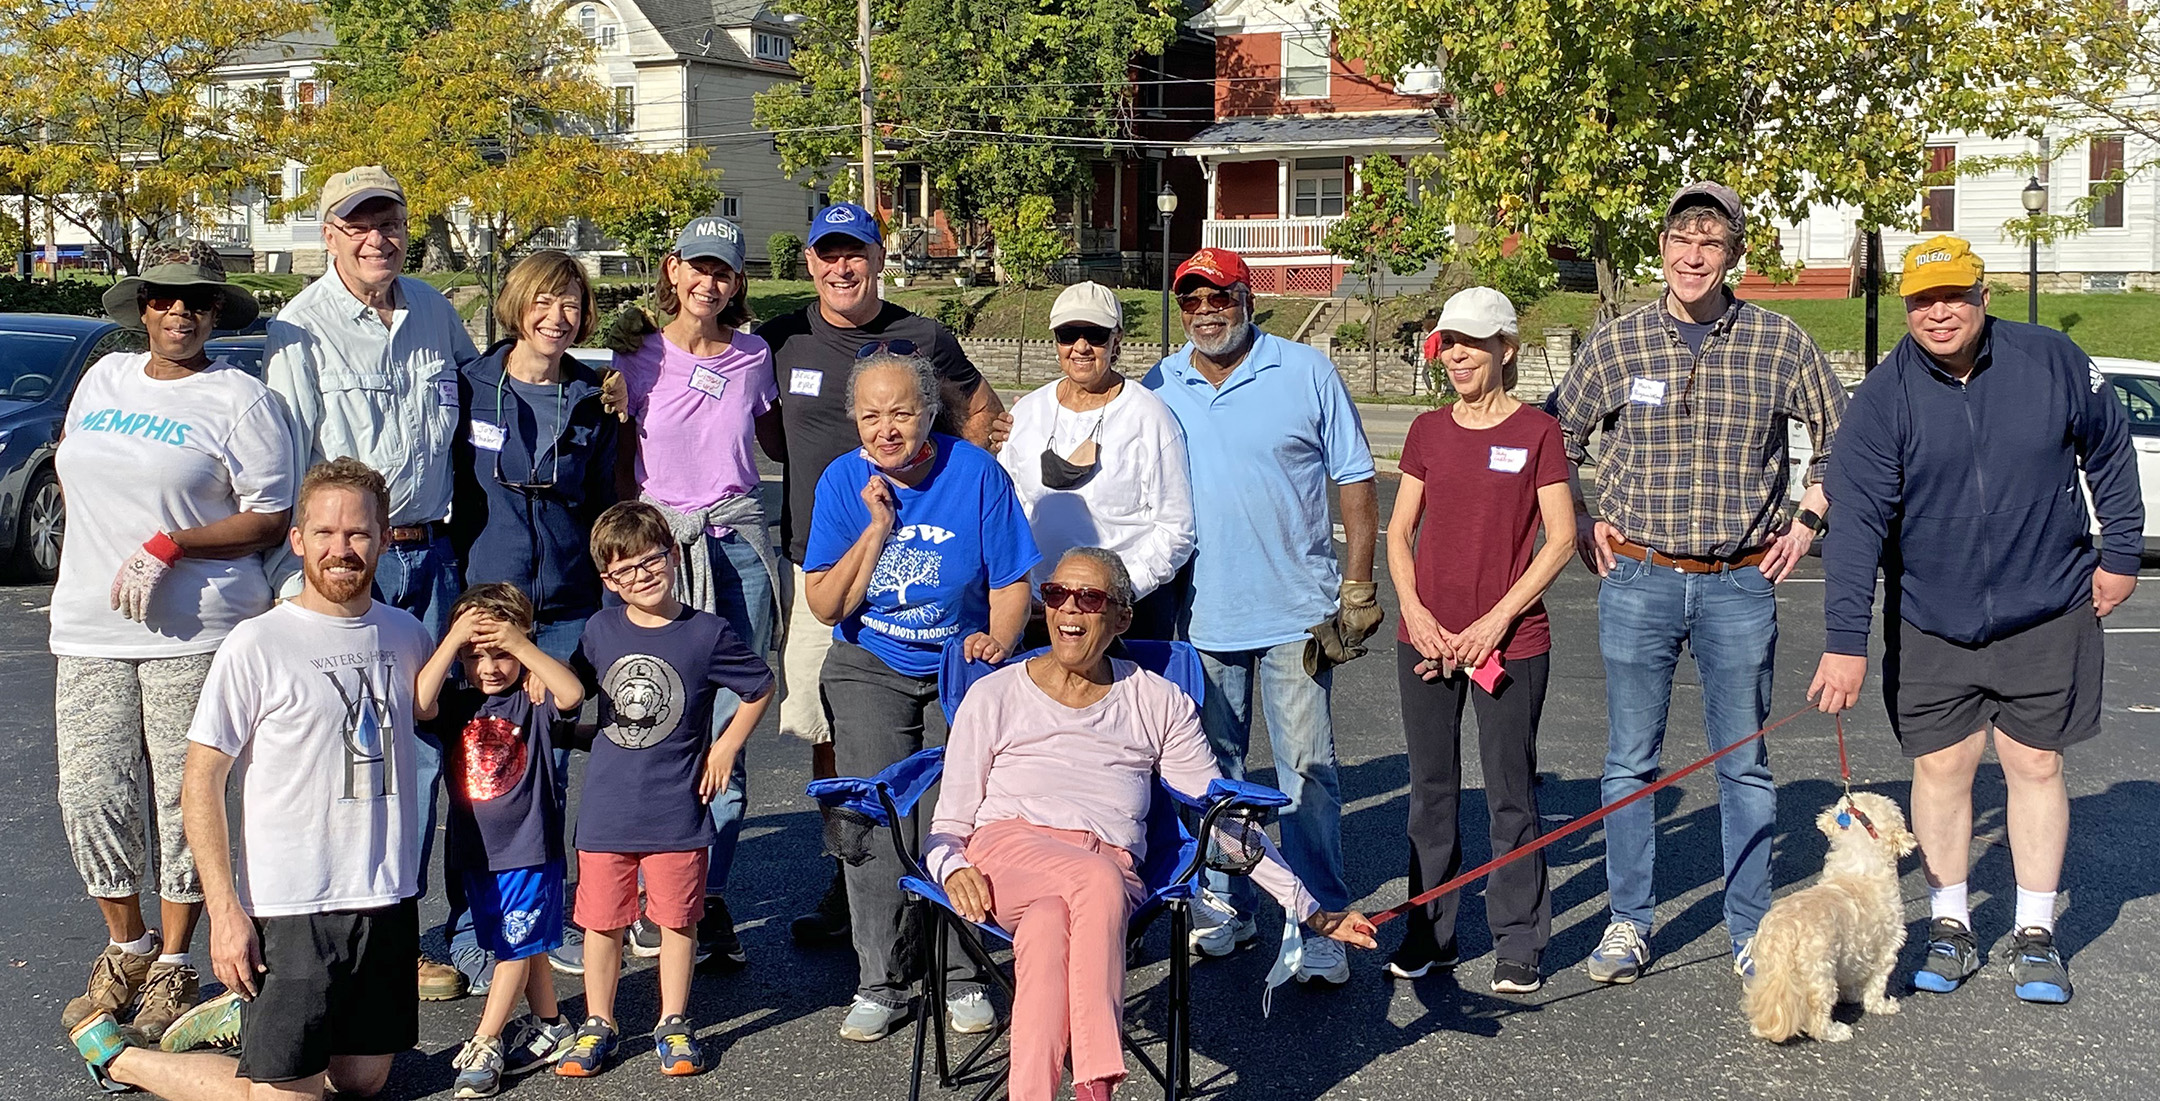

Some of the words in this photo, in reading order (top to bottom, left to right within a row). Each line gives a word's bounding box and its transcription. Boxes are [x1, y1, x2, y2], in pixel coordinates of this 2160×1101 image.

[696, 220, 738, 244] NASH
[1915, 252, 1952, 269] TOLEDO
[81, 408, 193, 446] MEMPHIS
[884, 524, 956, 545] SW
[860, 615, 889, 634] STRONG
[888, 626, 916, 640] ROOTS
[917, 624, 960, 640] PRODUCE
[309, 652, 365, 669] WATERS
[369, 650, 398, 662] HOPE
[636, 665, 646, 676] L
